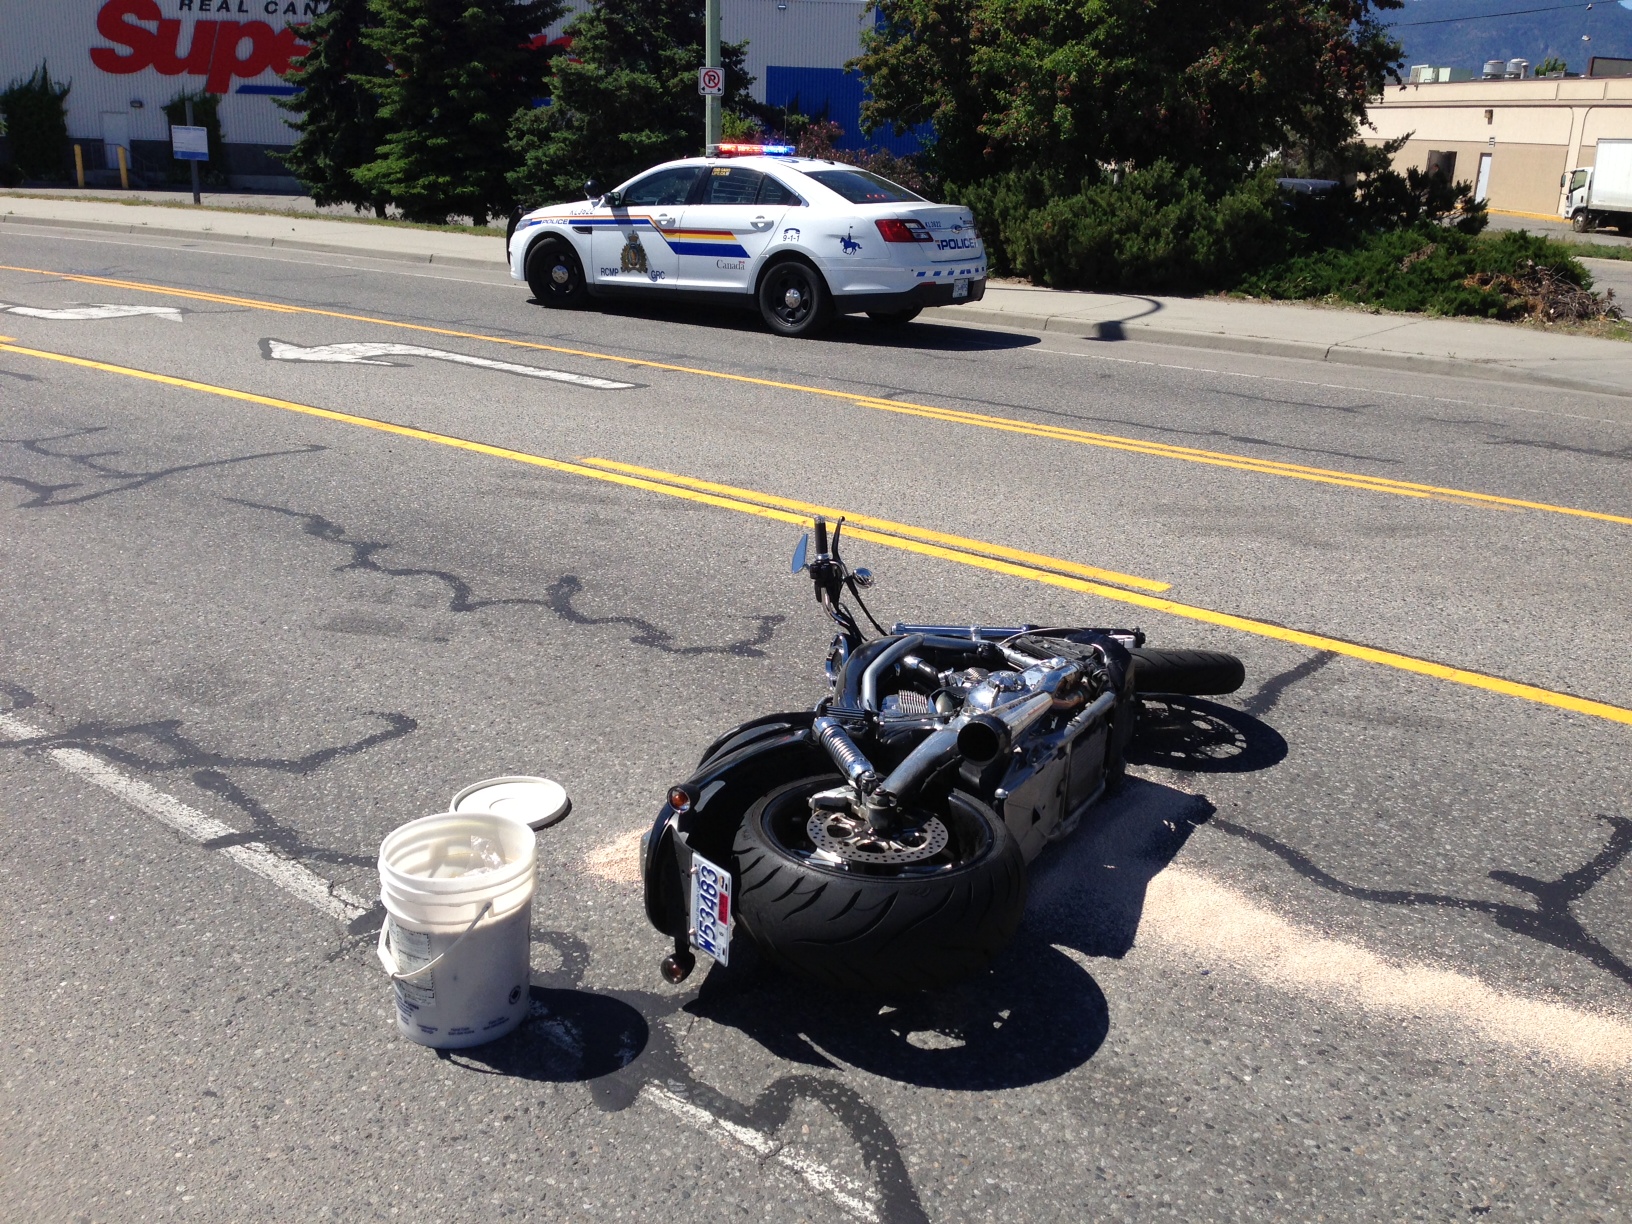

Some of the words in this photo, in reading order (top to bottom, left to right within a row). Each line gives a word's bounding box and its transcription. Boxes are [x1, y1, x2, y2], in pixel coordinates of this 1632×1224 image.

[178, 0, 249, 13] REAL
[783, 234, 800, 242] 9-1-1
[940, 238, 976, 250] POLICE
[716, 259, 746, 271] Canada
[600, 267, 619, 277] RCMP
[650, 270, 666, 280] GRC
[699, 865, 719, 955] W53483
